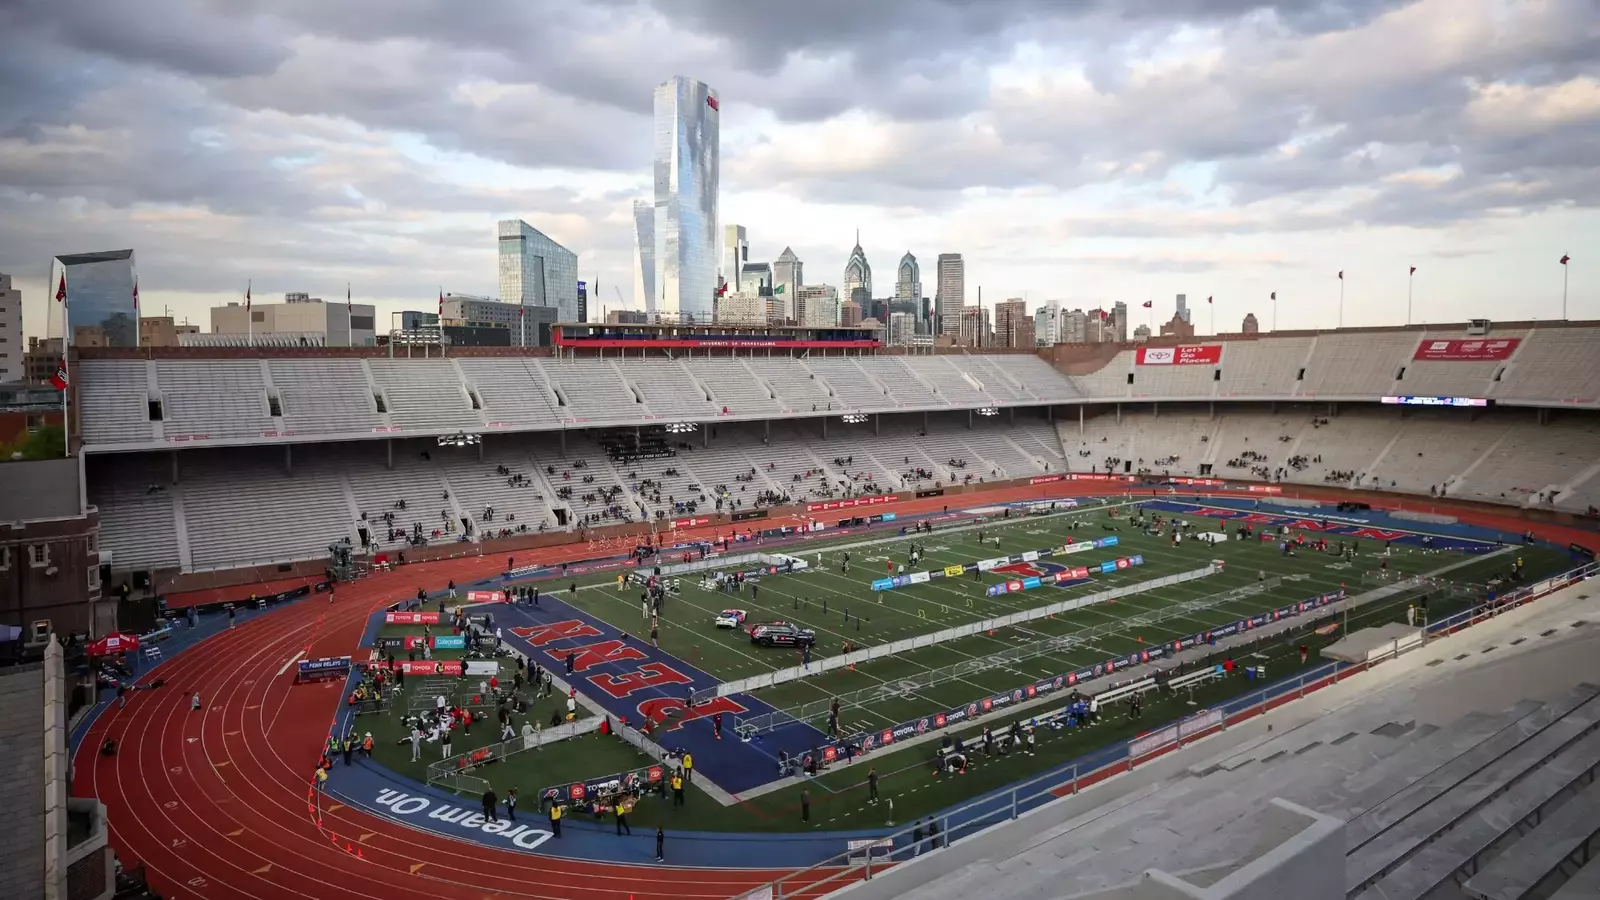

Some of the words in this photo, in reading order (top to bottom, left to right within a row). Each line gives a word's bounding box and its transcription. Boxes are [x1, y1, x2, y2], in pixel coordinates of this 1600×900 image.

[1114, 660, 1129, 668] TOYOTA
[508, 617, 750, 733] PENN
[1076, 671, 1092, 681] TOYOTA
[1036, 682, 1052, 693] TOYOTA
[992, 696, 1011, 706] TOYOTA
[946, 711, 966, 721] TOYOTA
[893, 727, 915, 740] TOYOTA
[375, 787, 431, 815] On.
[428, 804, 556, 850] Dream
